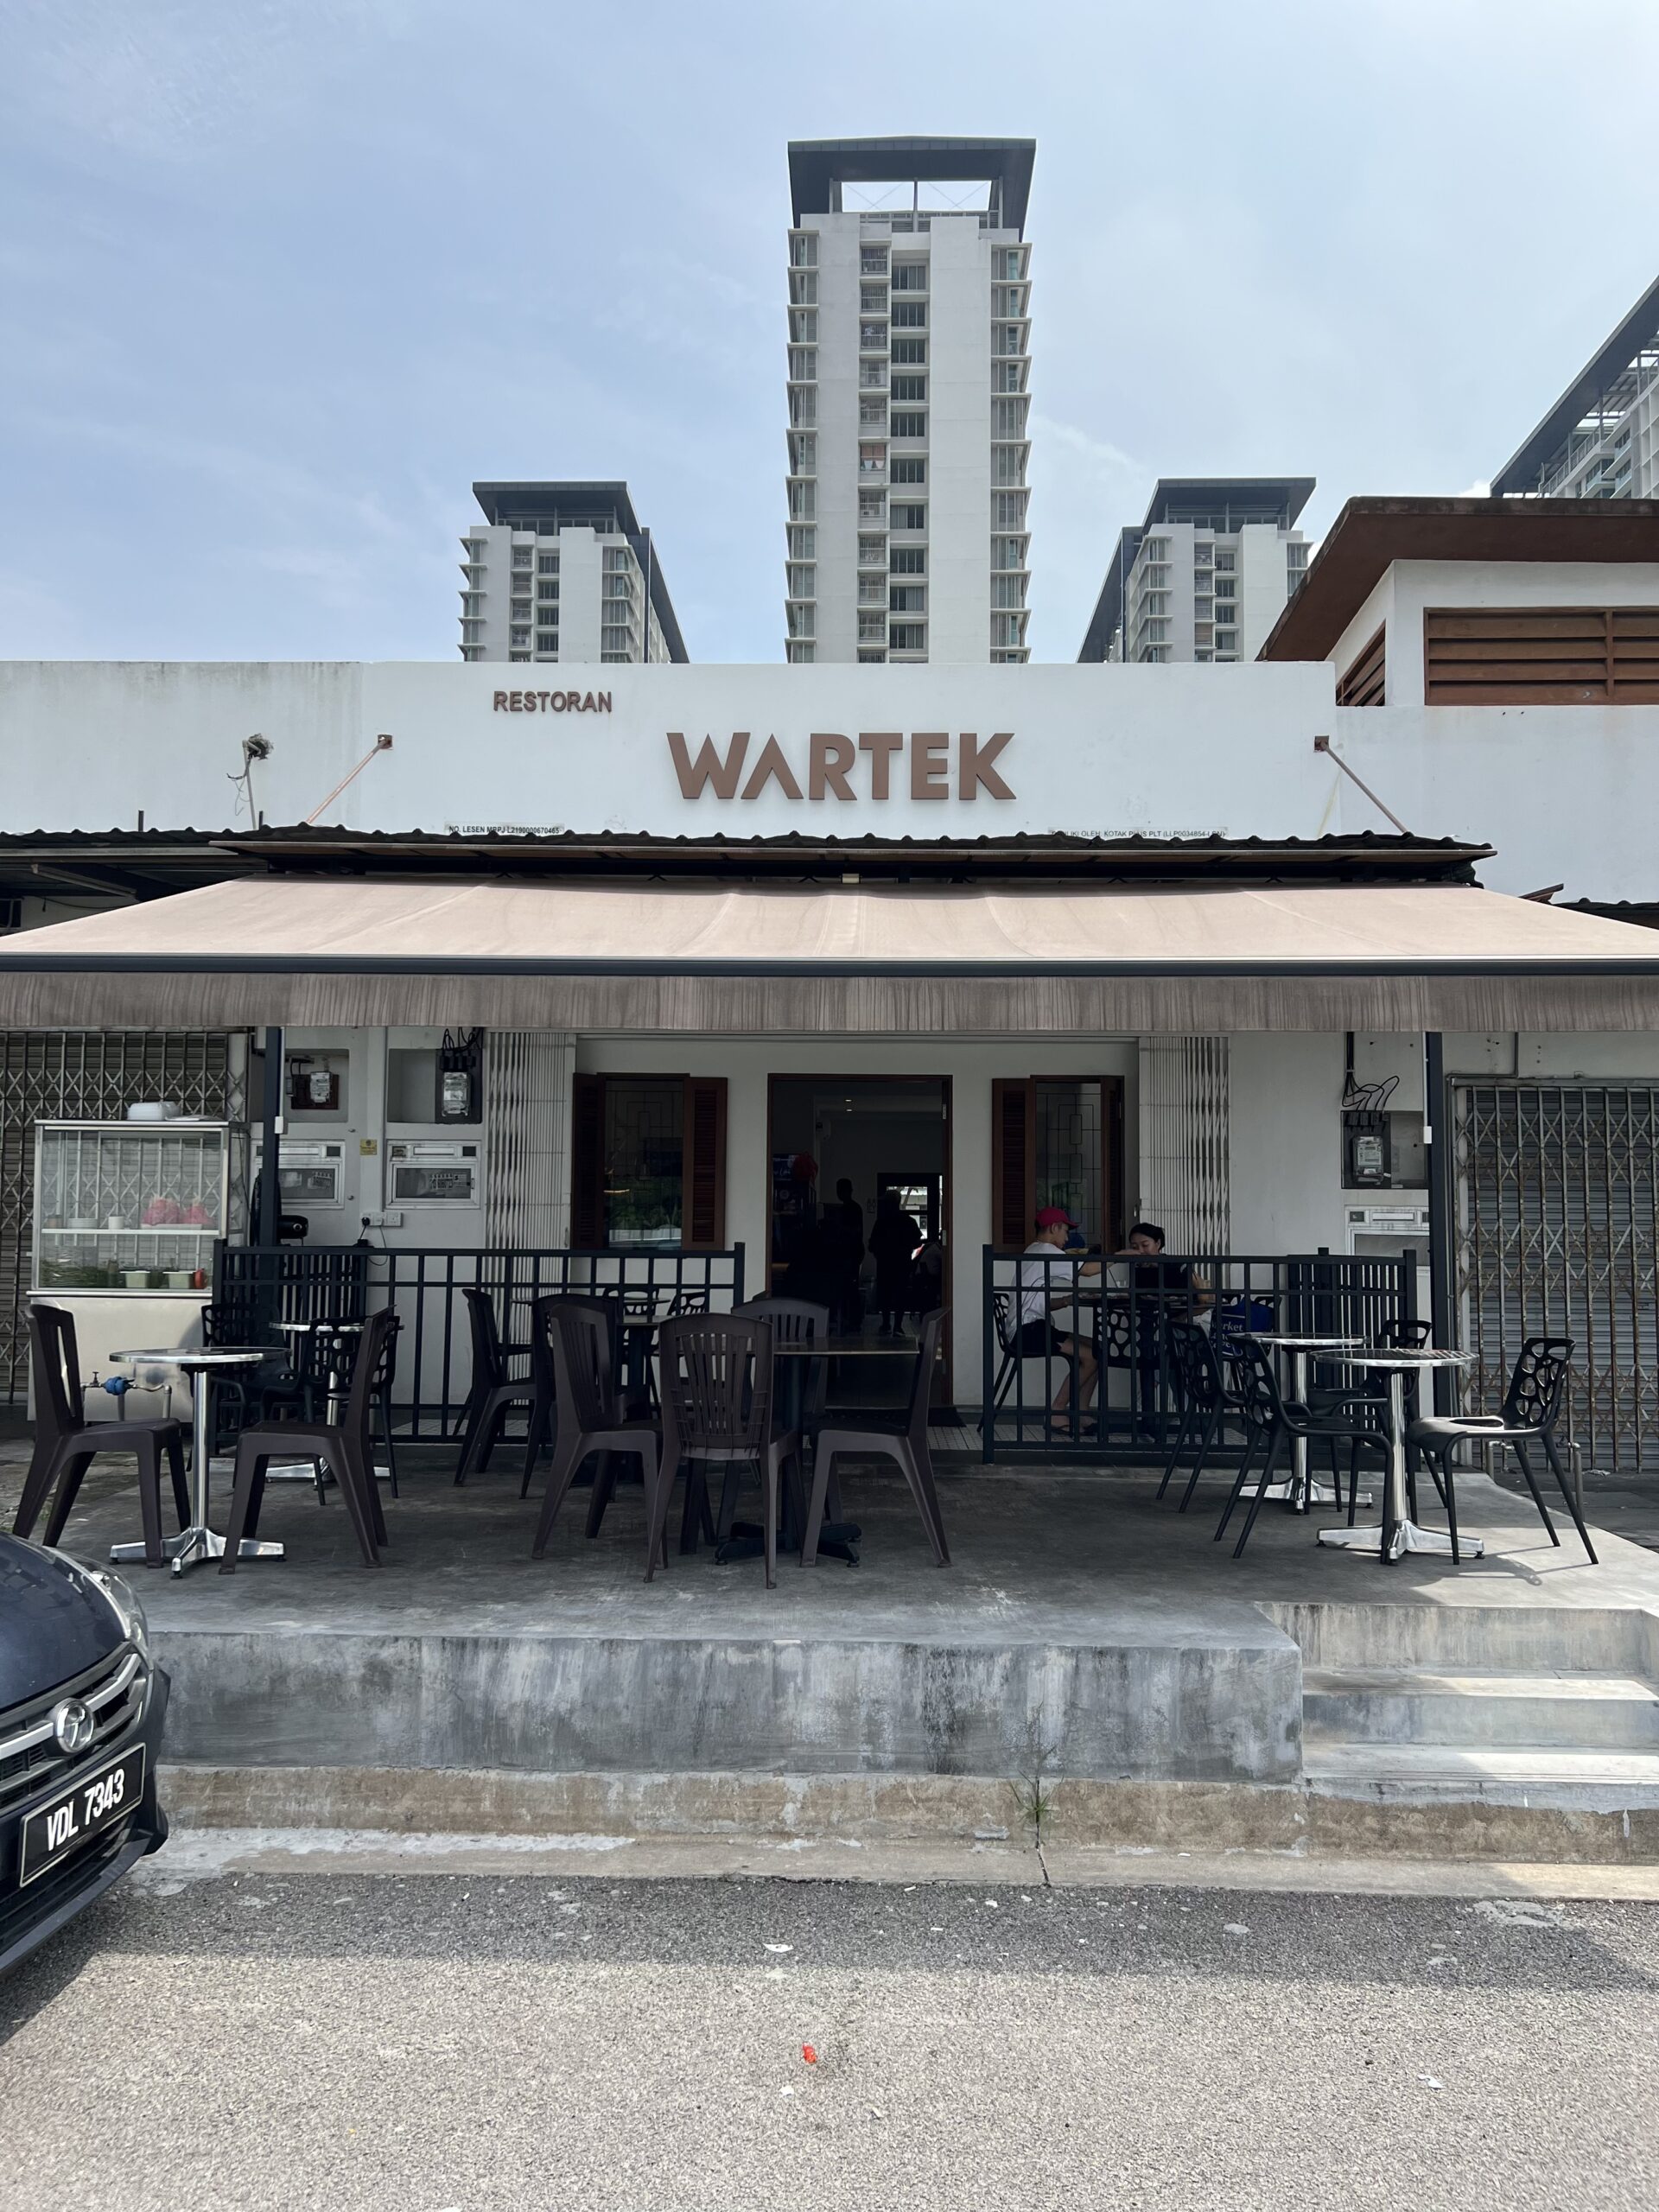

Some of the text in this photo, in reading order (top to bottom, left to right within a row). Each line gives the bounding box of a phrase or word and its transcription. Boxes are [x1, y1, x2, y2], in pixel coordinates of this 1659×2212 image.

[493, 690, 613, 713] RESTORAN
[666, 732, 1017, 801] WARTEK
[47, 1768, 124, 1852] VDL 7343
